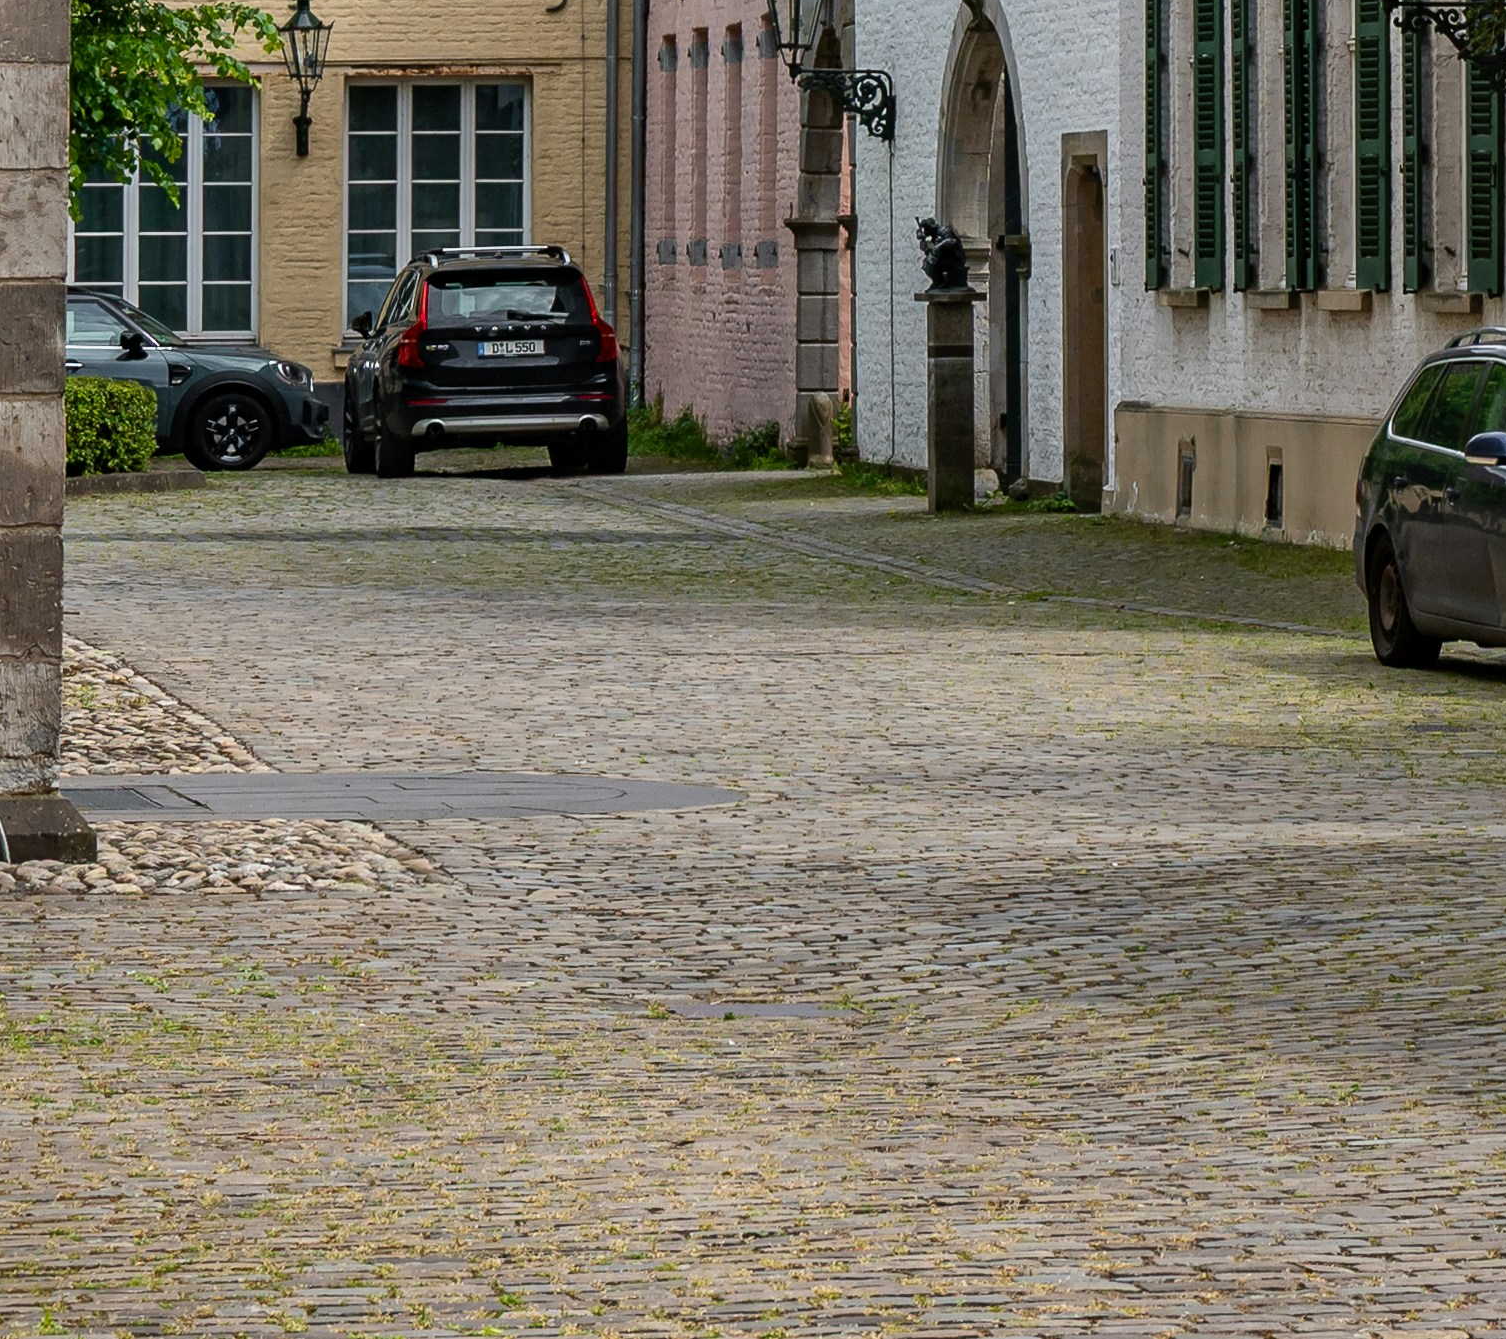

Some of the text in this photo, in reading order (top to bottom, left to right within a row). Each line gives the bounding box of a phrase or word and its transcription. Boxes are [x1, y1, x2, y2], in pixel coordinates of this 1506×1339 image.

[491, 341, 536, 354] D L 550
